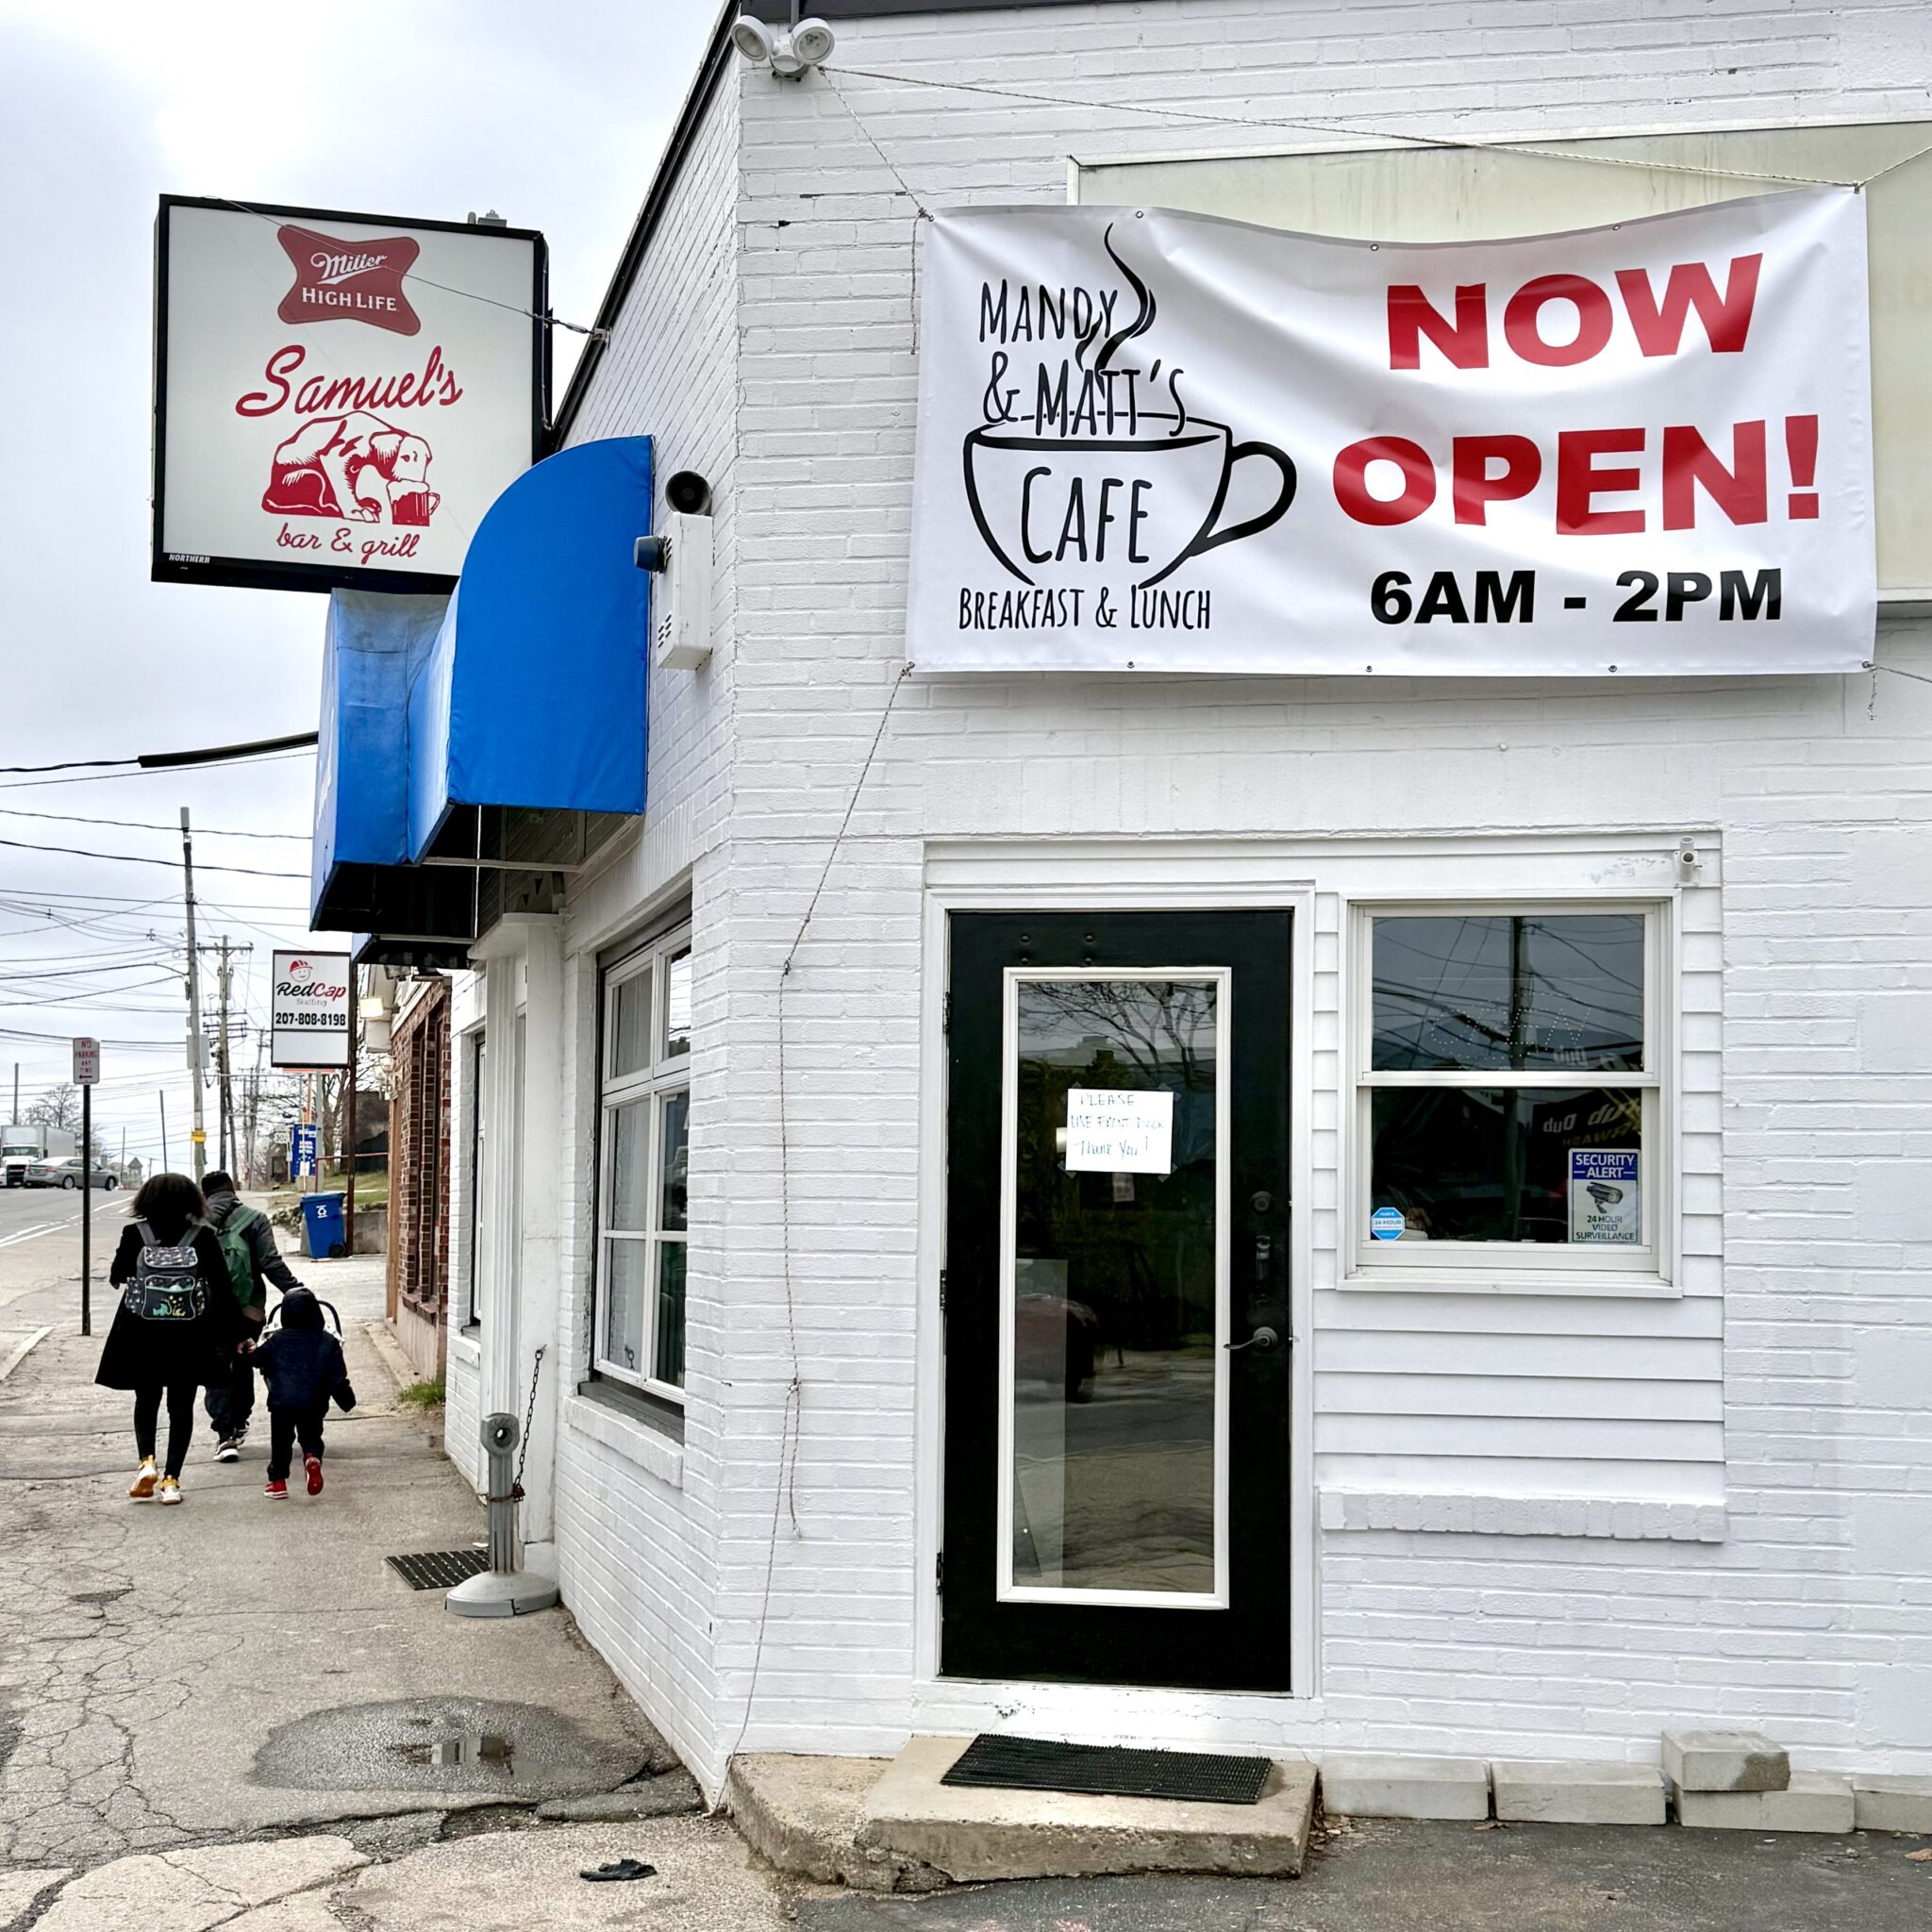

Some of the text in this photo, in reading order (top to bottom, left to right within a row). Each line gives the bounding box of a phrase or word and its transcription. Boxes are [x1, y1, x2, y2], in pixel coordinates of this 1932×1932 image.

[310, 251, 387, 285] Miller
[302, 287, 397, 311] HIGH LIFE
[979, 279, 1118, 344] MANDY
[1387, 253, 1763, 370] NOW
[235, 344, 463, 417] Samuel's
[983, 351, 1186, 437] & MATT'S
[1332, 414, 1820, 536] OPEN!
[1022, 467, 1153, 563] CAFE
[168, 553, 210, 564] NORTHERN
[276, 523, 419, 565] bar & grill
[958, 584, 1211, 631] BREAKFAST & LUNCH
[1370, 570, 1536, 625] 6AM
[1612, 568, 1781, 623] 2PM
[276, 982, 346, 1001] RedCap
[1080, 1093, 1135, 1107] PLEASE
[1071, 1114, 1092, 1128] USE
[1575, 1154, 1635, 1166] SECURITY
[1586, 1166, 1624, 1178] ALERT
[1592, 1224, 1618, 1232] VIDEO
[1598, 1215, 1623, 1224] HOUR
[1575, 1231, 1635, 1241] SURVEILLANCE
